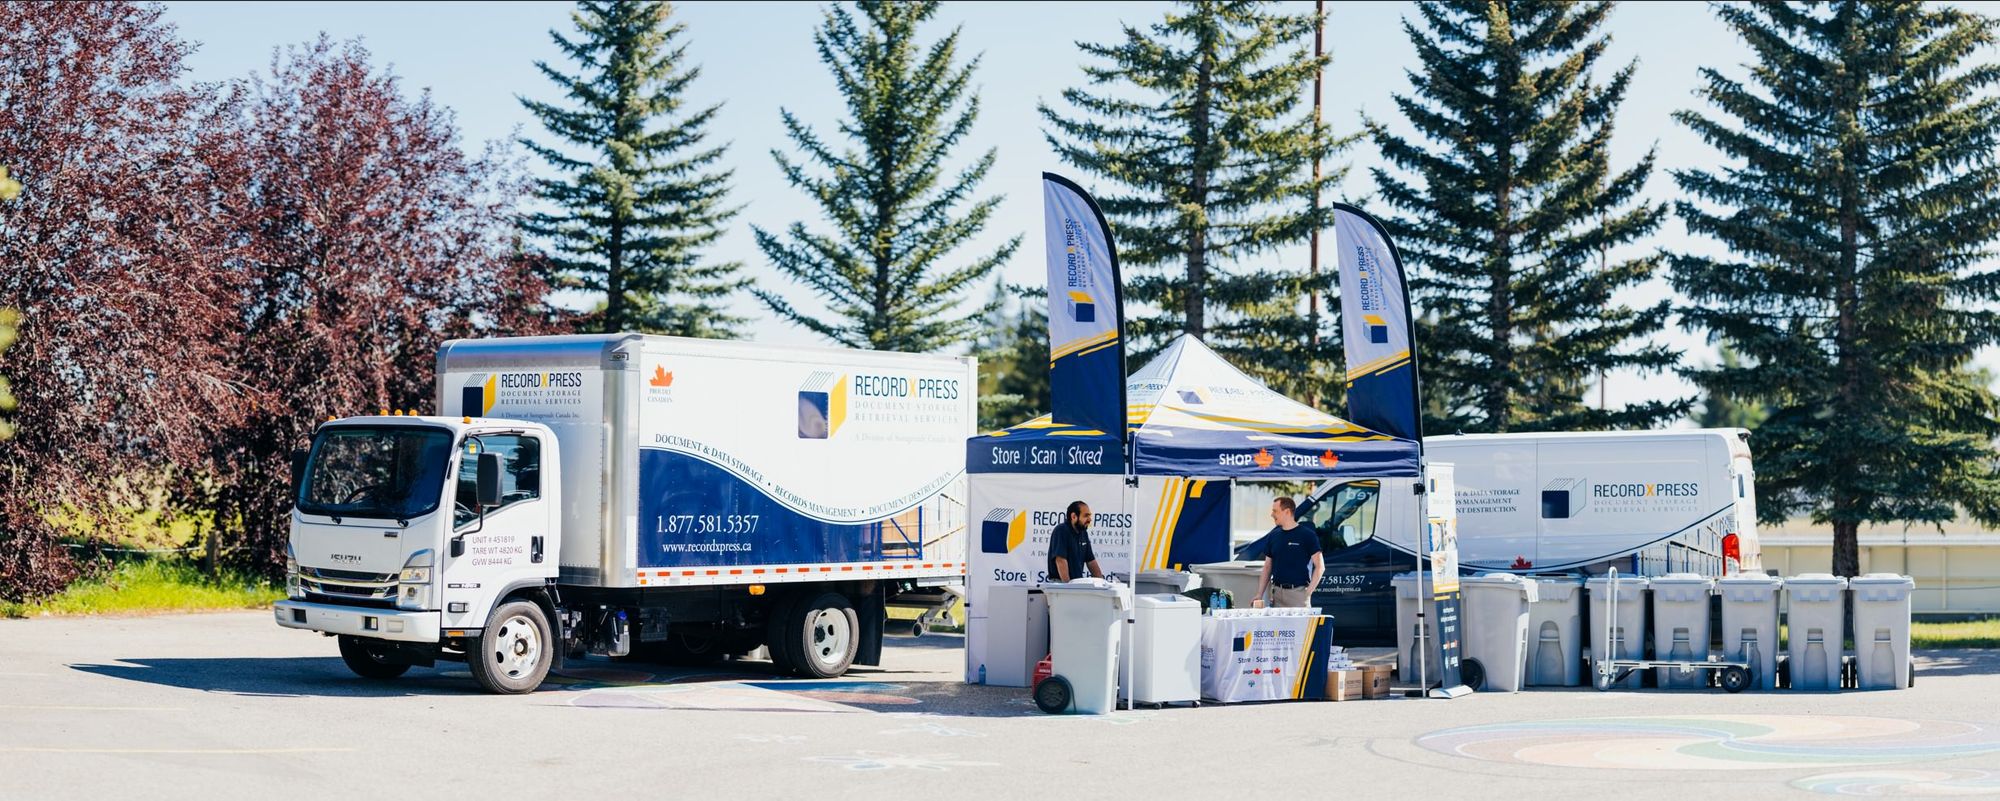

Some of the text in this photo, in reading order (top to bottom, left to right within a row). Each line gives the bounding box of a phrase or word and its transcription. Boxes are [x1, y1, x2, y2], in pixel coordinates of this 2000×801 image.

[501, 372, 582, 389] RECORDXPRESS
[855, 375, 959, 400] RECORDXPRESS
[547, 389, 581, 397] STORAGE
[855, 401, 958, 412] DOCUMENT STORAGE
[855, 412, 959, 424] RETRIEVAL SERVICES
[992, 445, 1103, 465] Store Scan Shred
[1219, 453, 1319, 467] SHOP STORE
[655, 433, 952, 517] DOCUMENT & DATA STORAGE RECORDS MANAGEMENT DOCUMENT DESTRUCTION
[1489, 488, 1520, 496] STORAGE
[1594, 483, 1698, 498] RECORDXPRESS
[1463, 497, 1512, 505] MANAGEMENT
[657, 515, 759, 534] 1.877.581.5357
[1033, 511, 1132, 529] RECOPRESS
[472, 536, 487, 544] UNIT
[493, 535, 515, 544] 451819
[488, 546, 498, 554] WT
[499, 546, 513, 554] 4820
[514, 545, 523, 554] KG
[662, 538, 752, 556] www.recordxpress.ca
[472, 557, 512, 566] GVW 8444 KG
[994, 568, 1027, 582] Store
